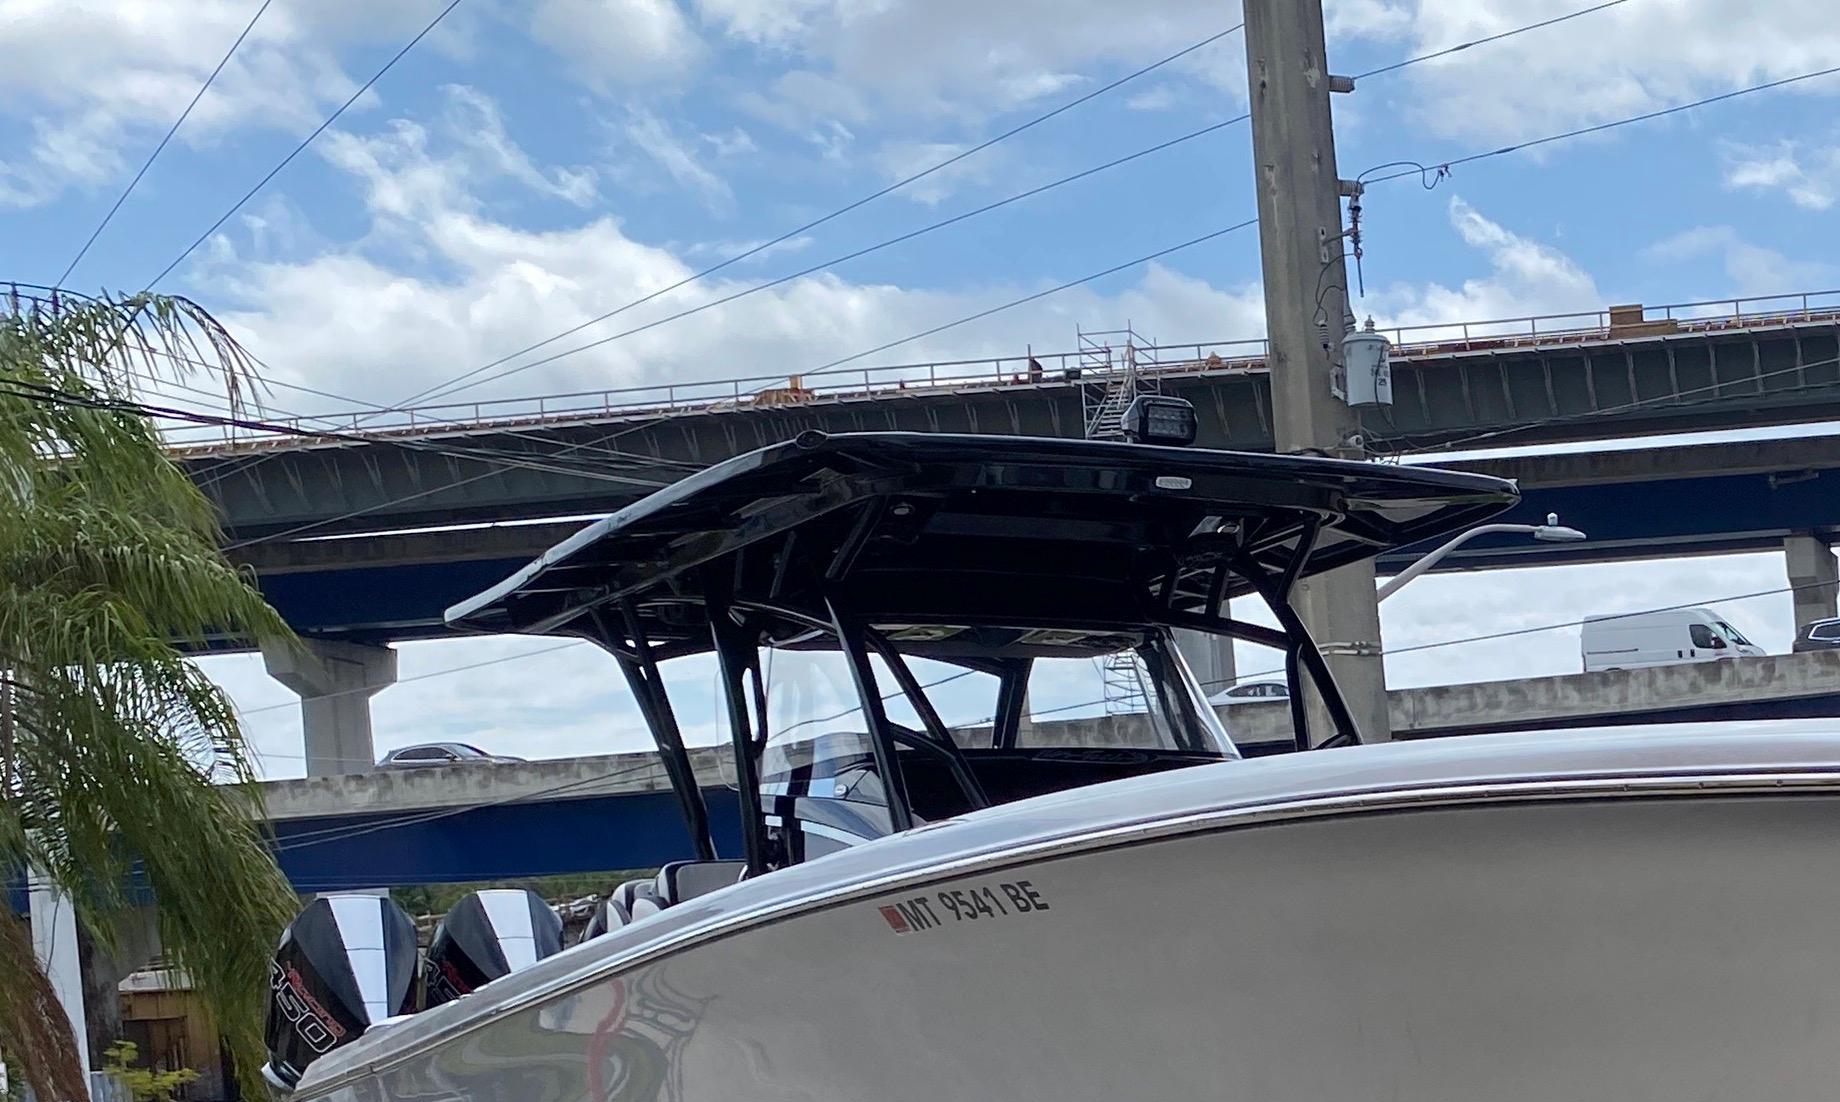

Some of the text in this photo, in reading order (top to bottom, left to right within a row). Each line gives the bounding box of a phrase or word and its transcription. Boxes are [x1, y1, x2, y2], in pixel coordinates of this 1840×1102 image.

[896, 881, 1050, 932] MT 9541 BE
[269, 957, 337, 1053] 450
